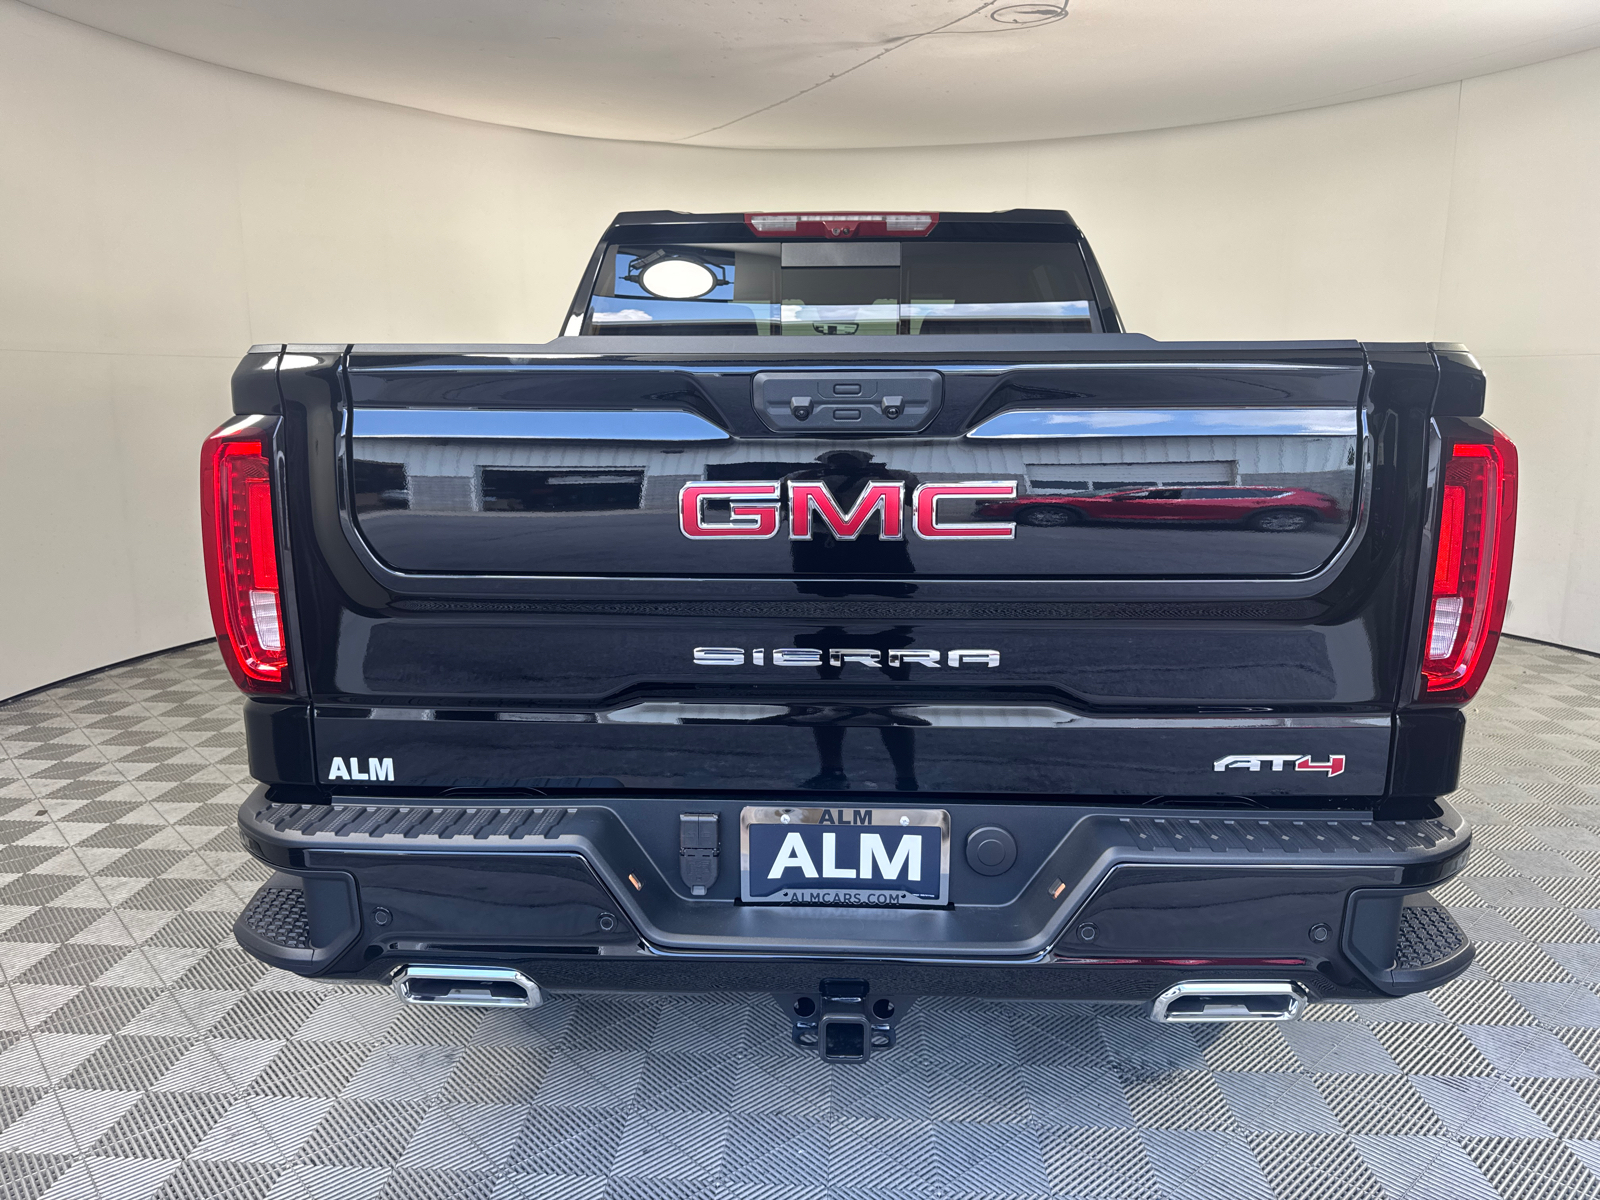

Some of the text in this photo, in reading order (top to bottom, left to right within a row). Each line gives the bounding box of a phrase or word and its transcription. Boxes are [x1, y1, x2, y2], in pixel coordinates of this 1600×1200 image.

[679, 480, 1018, 541] GMC
[693, 647, 1001, 668] SIERRA
[328, 756, 395, 781] ALM
[1213, 754, 1346, 778] AT4
[818, 809, 873, 826] ALM
[767, 832, 923, 881] ALM
[789, 892, 900, 905] ALMCARS.COM
